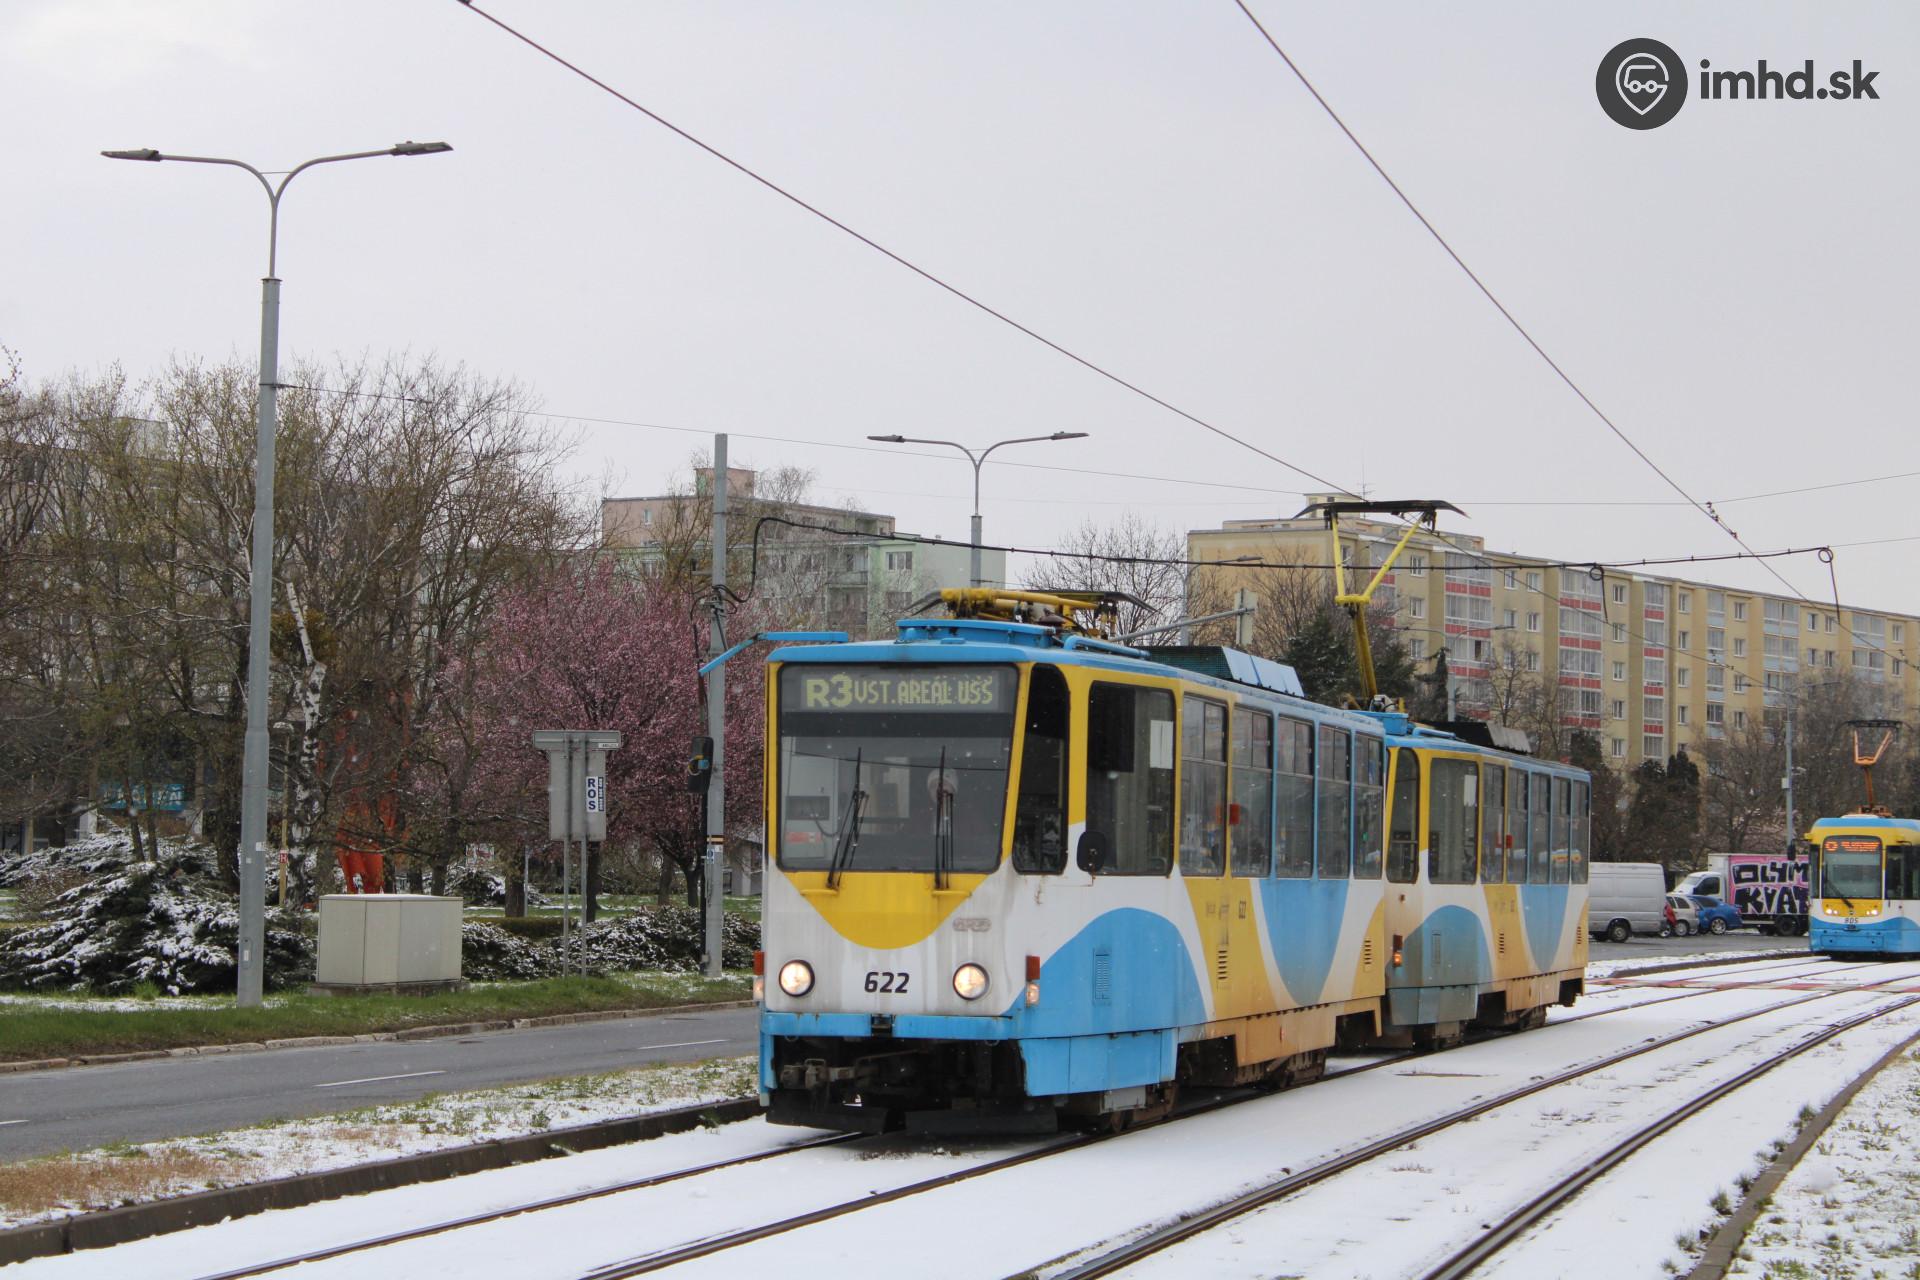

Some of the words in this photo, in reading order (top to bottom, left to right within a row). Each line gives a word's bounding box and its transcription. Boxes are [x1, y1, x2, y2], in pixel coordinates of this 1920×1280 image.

[805, 673, 852, 708] R3
[587, 778, 597, 811] ROS
[864, 971, 910, 994] 622
